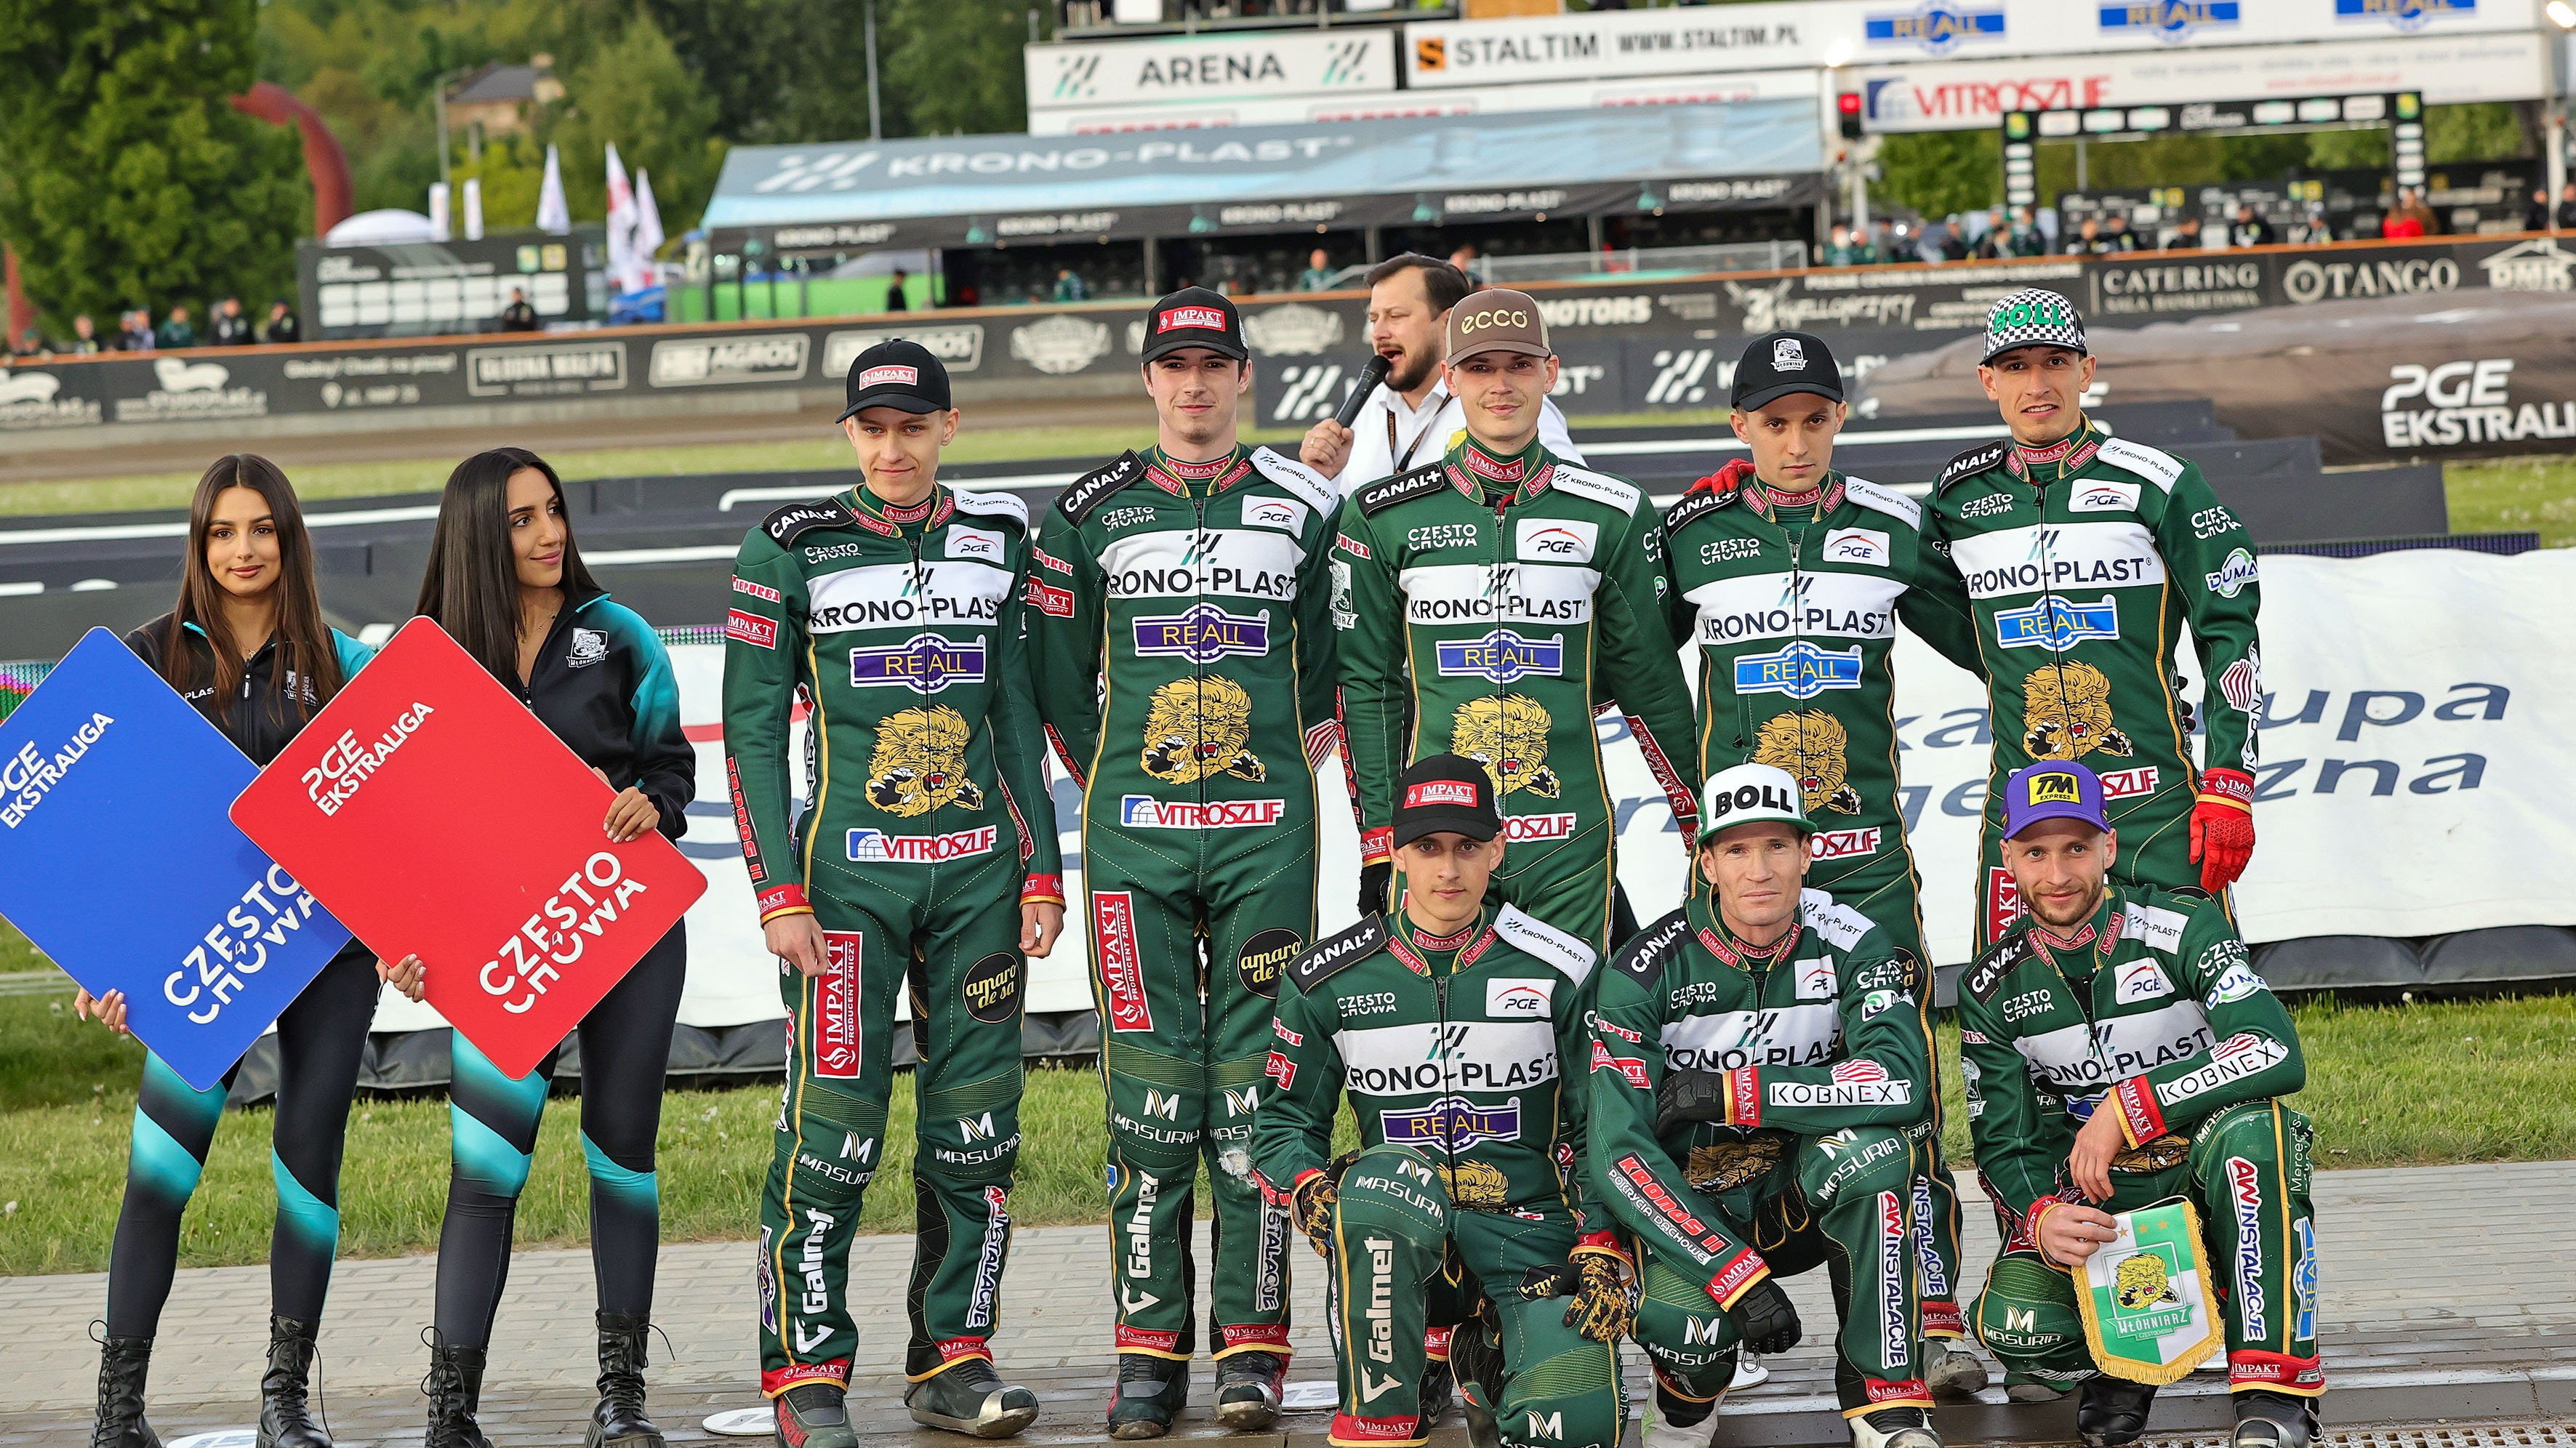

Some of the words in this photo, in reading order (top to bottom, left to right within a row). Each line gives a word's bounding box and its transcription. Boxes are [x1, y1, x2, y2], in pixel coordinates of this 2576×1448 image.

[1455, 33, 1599, 67] STALTIM
[1616, 24, 1802, 54] WWW.STALTIM.PL
[1138, 51, 1287, 88] ARENA
[888, 137, 1333, 177] KRONO-PLAST
[2103, 262, 2259, 294] CATERING
[2325, 259, 2460, 295] TANGO
[1173, 310, 1221, 321] IMPAKT
[1461, 310, 1528, 334] ecco
[1993, 303, 2066, 334] BOLL
[2382, 358, 2515, 411] PGE
[1476, 453, 1522, 476] IMPAKT
[2028, 444, 2069, 458] IMPAKT
[2119, 450, 2175, 478] KRONO-PLAST
[1179, 460, 1229, 475] IMPAKT
[1275, 464, 1332, 500] KRONO-PLAST
[1064, 460, 1131, 513] CANAL+
[1365, 470, 1441, 505] CANAL+
[1570, 477, 1630, 500] KRONO-PLAST
[1778, 490, 1818, 504] IMPAKT
[2085, 495, 2121, 505] PGE
[896, 504, 930, 520] IMPAKT
[1259, 512, 1292, 523] PGE
[1666, 491, 1736, 526] CANAL+
[1865, 488, 1918, 518] KRONO-PLAST
[770, 510, 838, 539] CANAL+
[960, 544, 991, 553] PGE
[1538, 541, 1576, 553] PGE
[1839, 546, 1871, 558] PGE
[1411, 596, 1582, 619] KRONO-PLAST
[727, 616, 772, 637] IMPAKT
[1163, 624, 1245, 645] REALL
[1704, 608, 1886, 640] KRONO-PLAST
[2020, 614, 2095, 636] REALL
[884, 653, 968, 675] REALL
[1464, 648, 1541, 667] REALL
[1762, 661, 1840, 681] REALL
[0, 712, 114, 829] EKSTRALIGA
[301, 728, 366, 804] PGE
[316, 701, 435, 817] EKSTRALIGA
[1421, 784, 1473, 797] IMPAKT
[2037, 776, 2073, 795] TM
[1715, 785, 1793, 819] BOLL
[1118, 901, 1130, 938] ZNICZY
[1101, 900, 1134, 1001] IMPAKT
[1299, 927, 1376, 976] CANAL+
[1425, 930, 1471, 947] IMPAKT
[1521, 928, 1584, 962] KRONO-PLAST
[1630, 918, 1687, 973] CANAL+
[1709, 938, 1738, 965] IMPAKT
[1123, 939, 1140, 1001] PRODUCENT
[1240, 941, 1302, 970] amaro
[1972, 938, 2023, 994] CANAL+
[827, 939, 843, 1044] IMPAKT
[966, 964, 1018, 997] amaro
[978, 992, 996, 1009] de
[998, 980, 1015, 1000] sa
[1504, 999, 1538, 1010] PGE
[2160, 1039, 2285, 1103] KOBNEXT
[1741, 1066, 1754, 1119] IMPAKT
[1773, 1083, 1910, 1103] KOBNEXT
[2126, 1079, 2154, 1133] IMPAKT
[1411, 1115, 1497, 1136] REALL
[936, 1133, 1022, 1165] MASURIA
[1816, 1138, 1902, 1200] MASURIA
[1618, 1157, 1707, 1237] KRONOS
[1653, 1216, 1708, 1265] DACHOWE
[799, 1207, 835, 1314] Galmet
[1720, 1252, 1760, 1287] IMPAKT
[1364, 1236, 1394, 1364] Galmet
[1983, 1325, 2062, 1346] MASURIA
[2235, 1364, 2281, 1372] IMPAKT
[1366, 1422, 1414, 1431] IMPAKT
